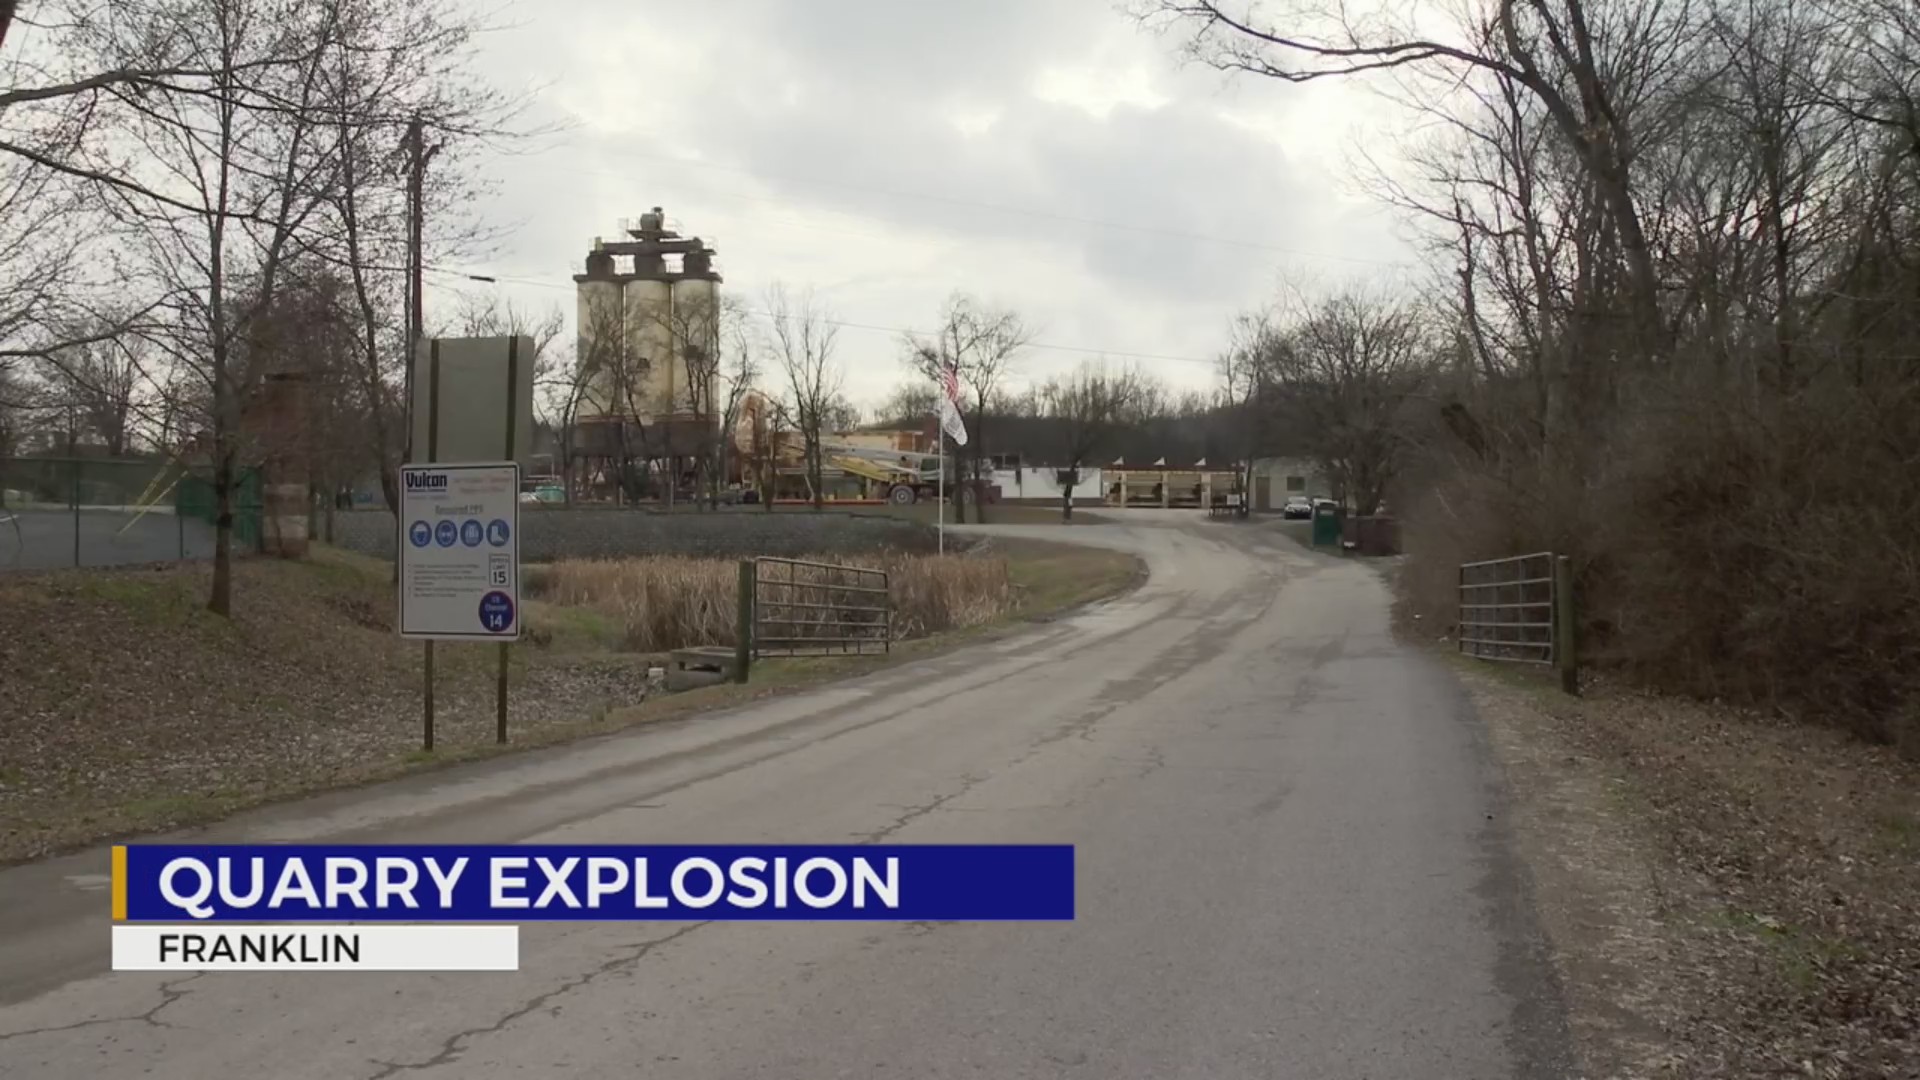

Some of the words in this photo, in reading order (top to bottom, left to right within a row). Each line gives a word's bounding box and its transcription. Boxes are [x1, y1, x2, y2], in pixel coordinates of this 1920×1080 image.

[406, 472, 447, 488] Vulcan
[493, 571, 506, 584] 15
[490, 614, 502, 627] 14
